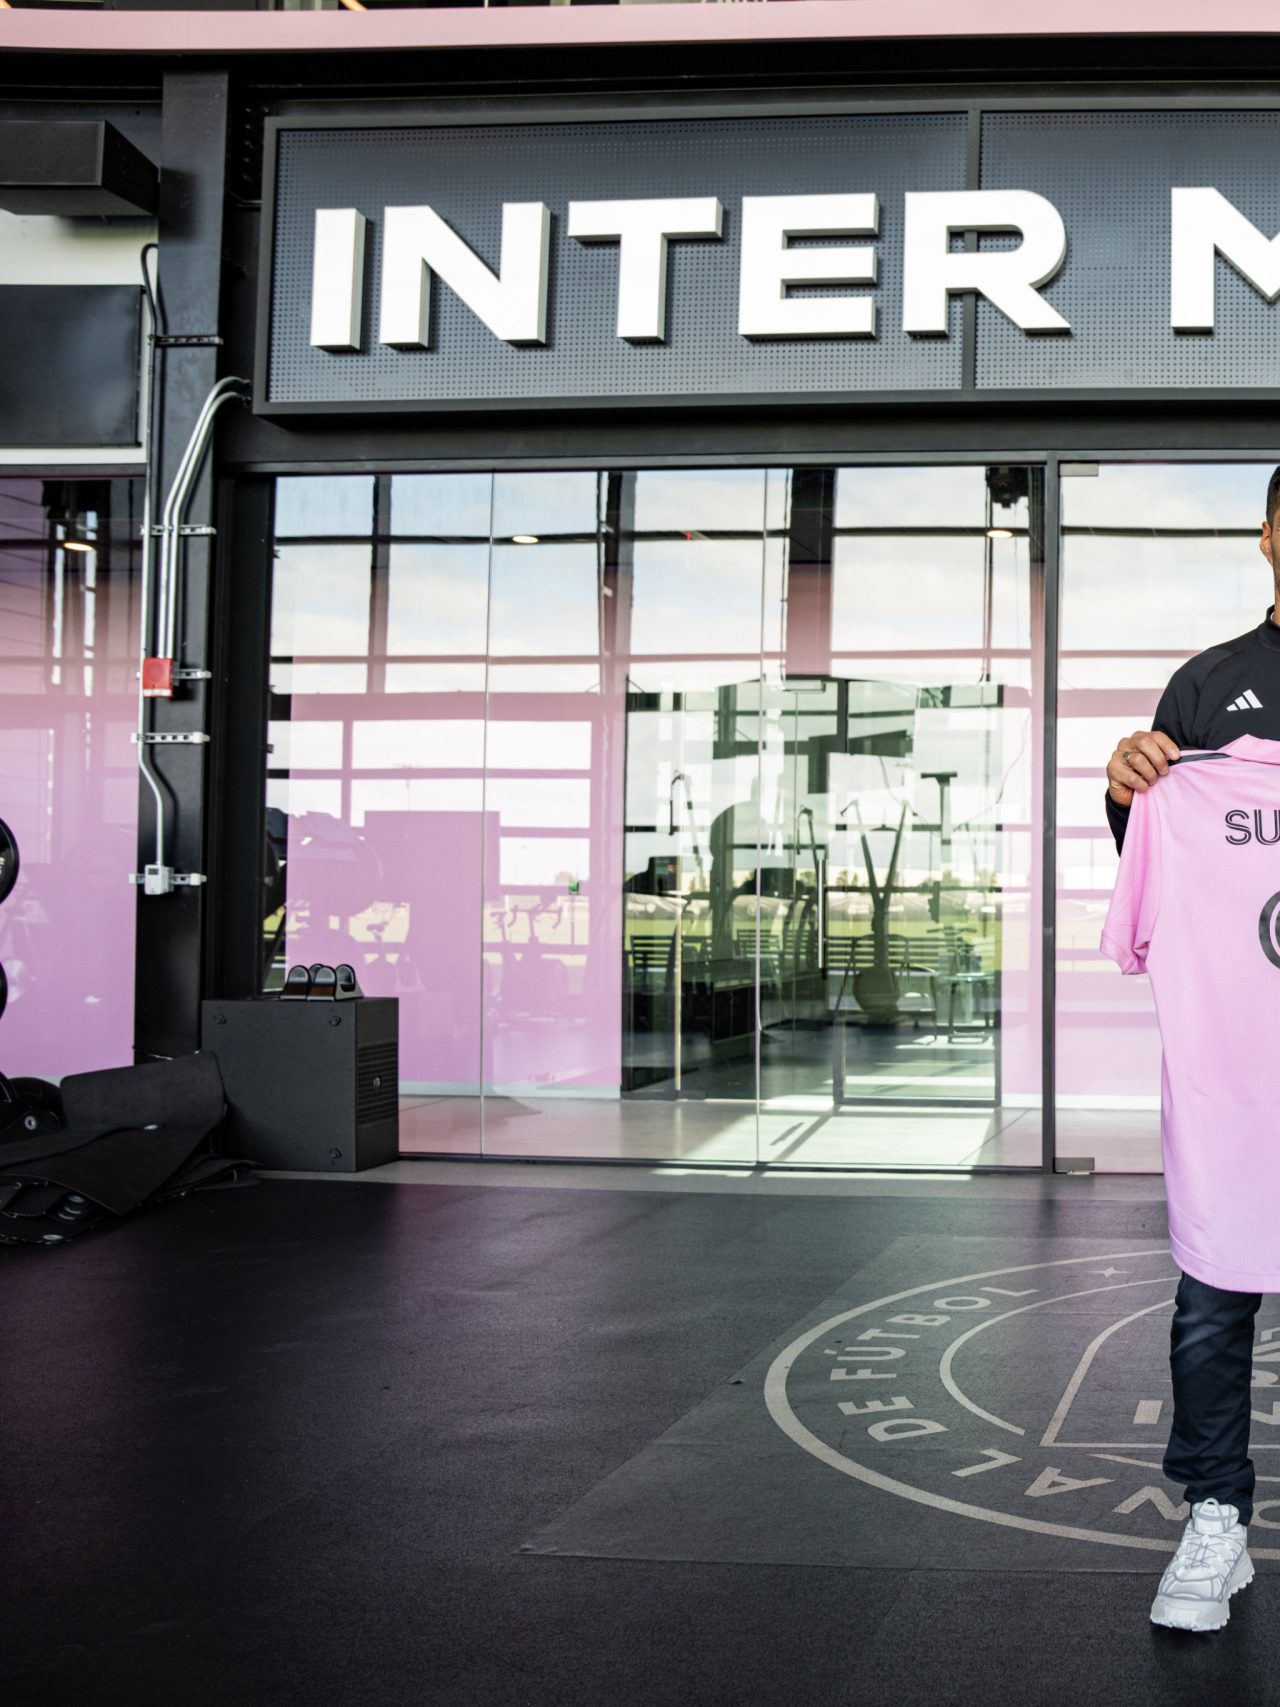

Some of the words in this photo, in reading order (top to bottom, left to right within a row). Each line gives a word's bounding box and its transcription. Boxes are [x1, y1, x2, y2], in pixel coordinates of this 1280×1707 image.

[310, 189, 1072, 349] INTER
[823, 1286, 1040, 1382] FÚTBOL
[837, 1396, 949, 1442] DE
